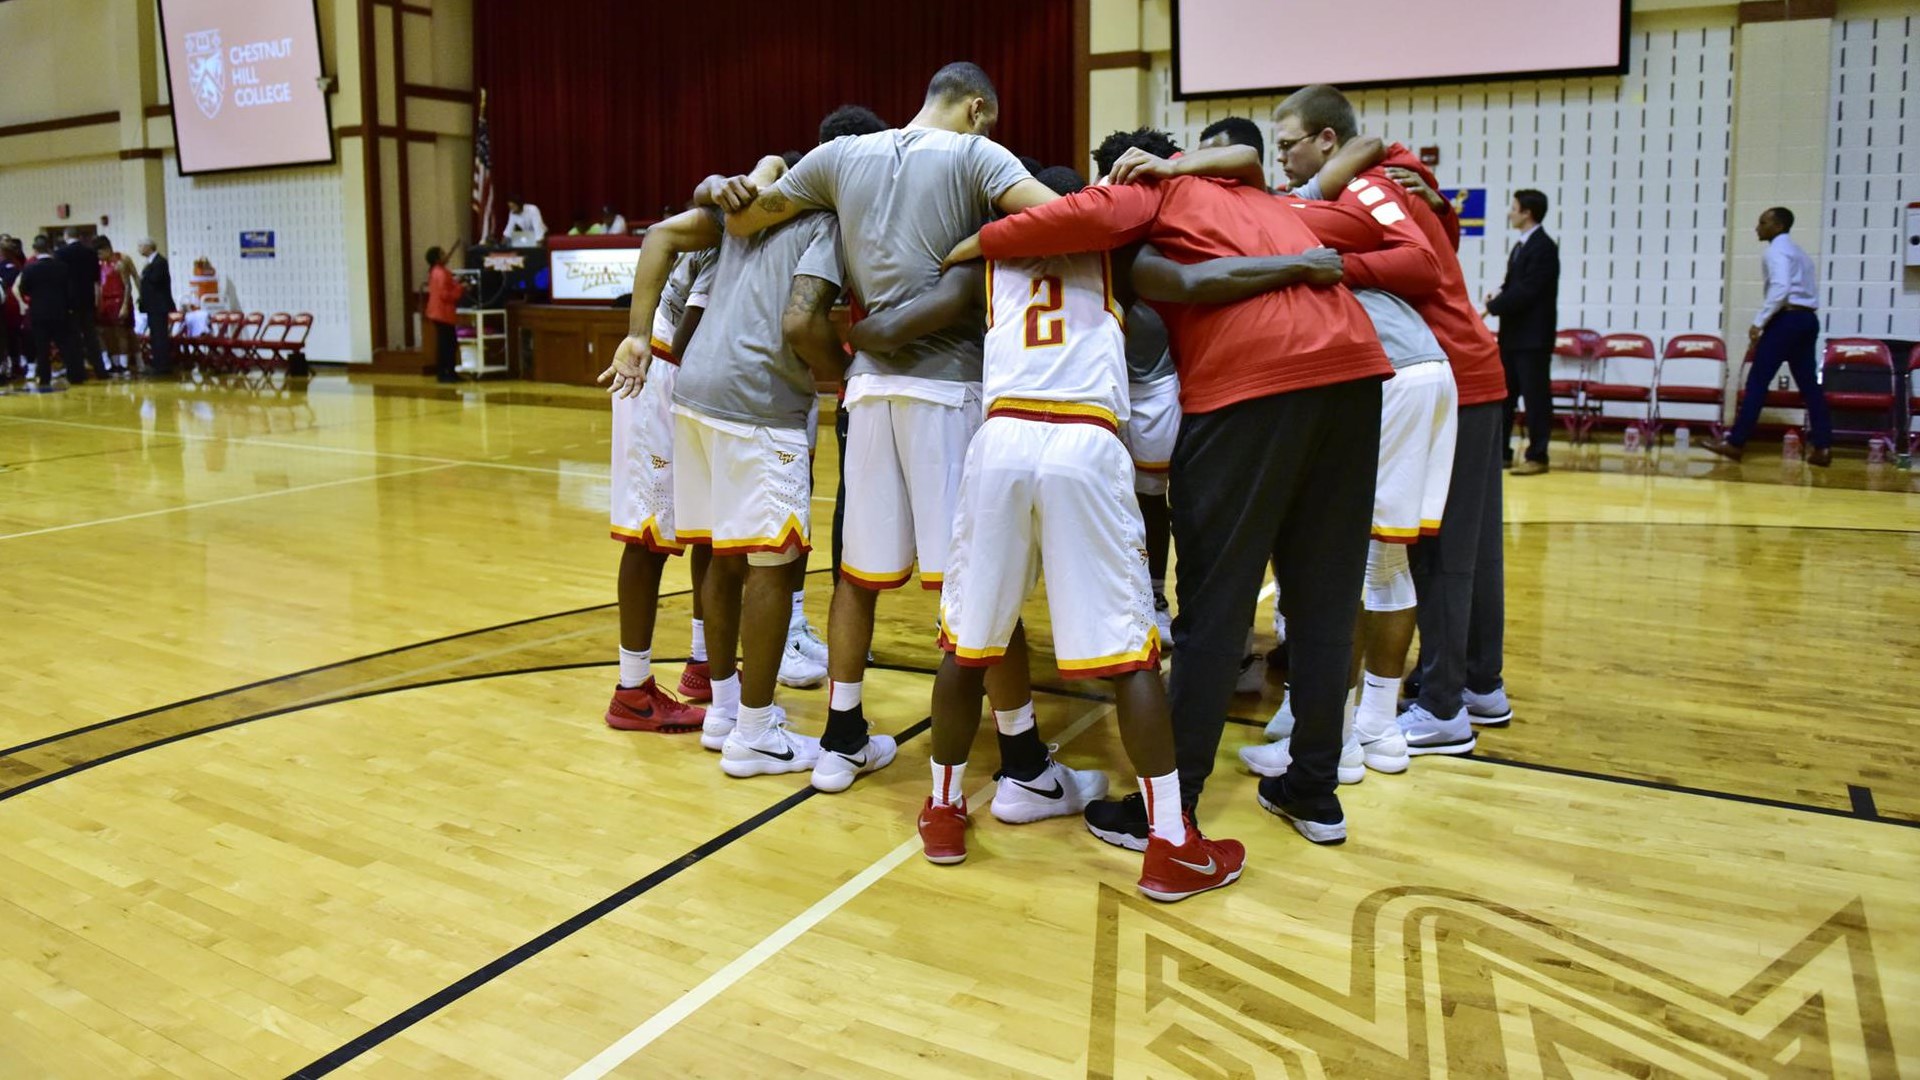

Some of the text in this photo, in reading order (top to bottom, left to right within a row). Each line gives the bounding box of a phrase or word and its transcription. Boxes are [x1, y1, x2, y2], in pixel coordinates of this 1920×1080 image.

[230, 38, 291, 64] CHESTNUT
[232, 66, 258, 85] HILL
[235, 83, 291, 107] COLLEGE
[1023, 275, 1065, 350] 2
